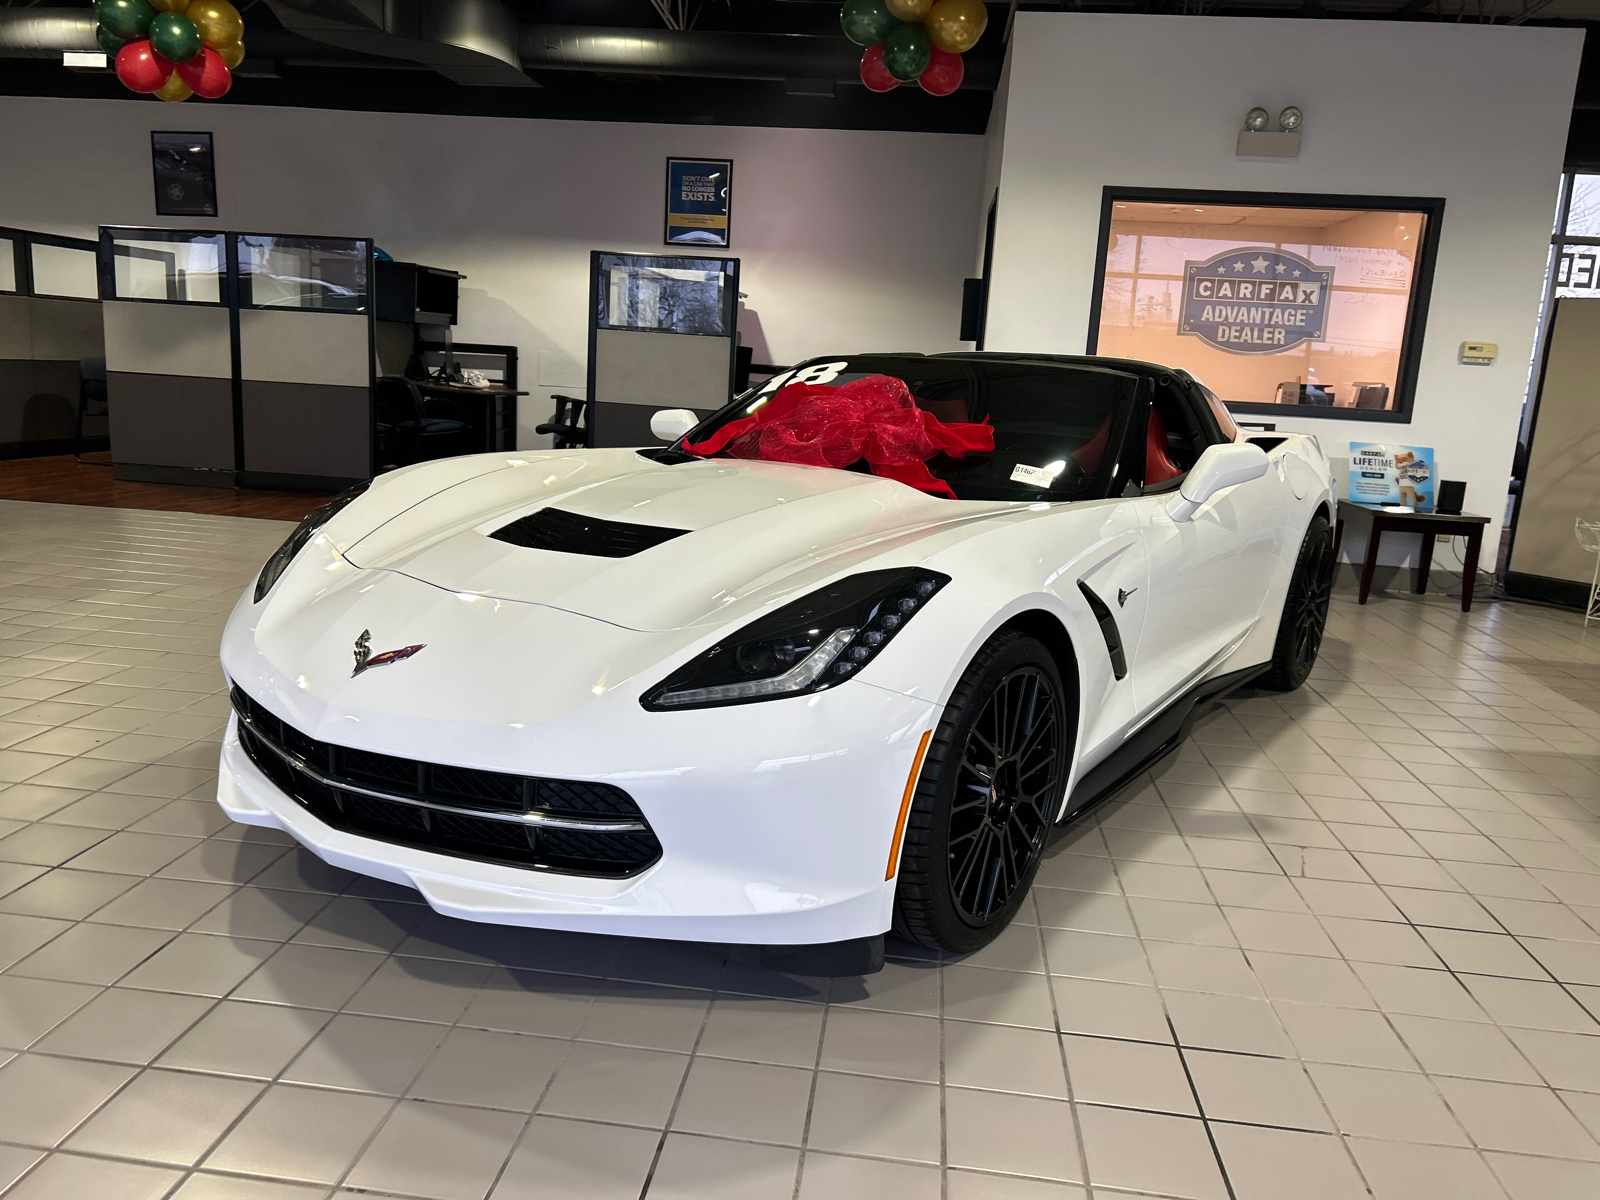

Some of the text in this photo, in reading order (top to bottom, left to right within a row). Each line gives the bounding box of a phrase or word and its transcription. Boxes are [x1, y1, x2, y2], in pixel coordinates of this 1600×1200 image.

[1198, 281, 1316, 304] CARFAX
[1217, 325, 1286, 345] DEALER
[757, 361, 848, 395] 18
[1354, 456, 1393, 468] LIFETIME
